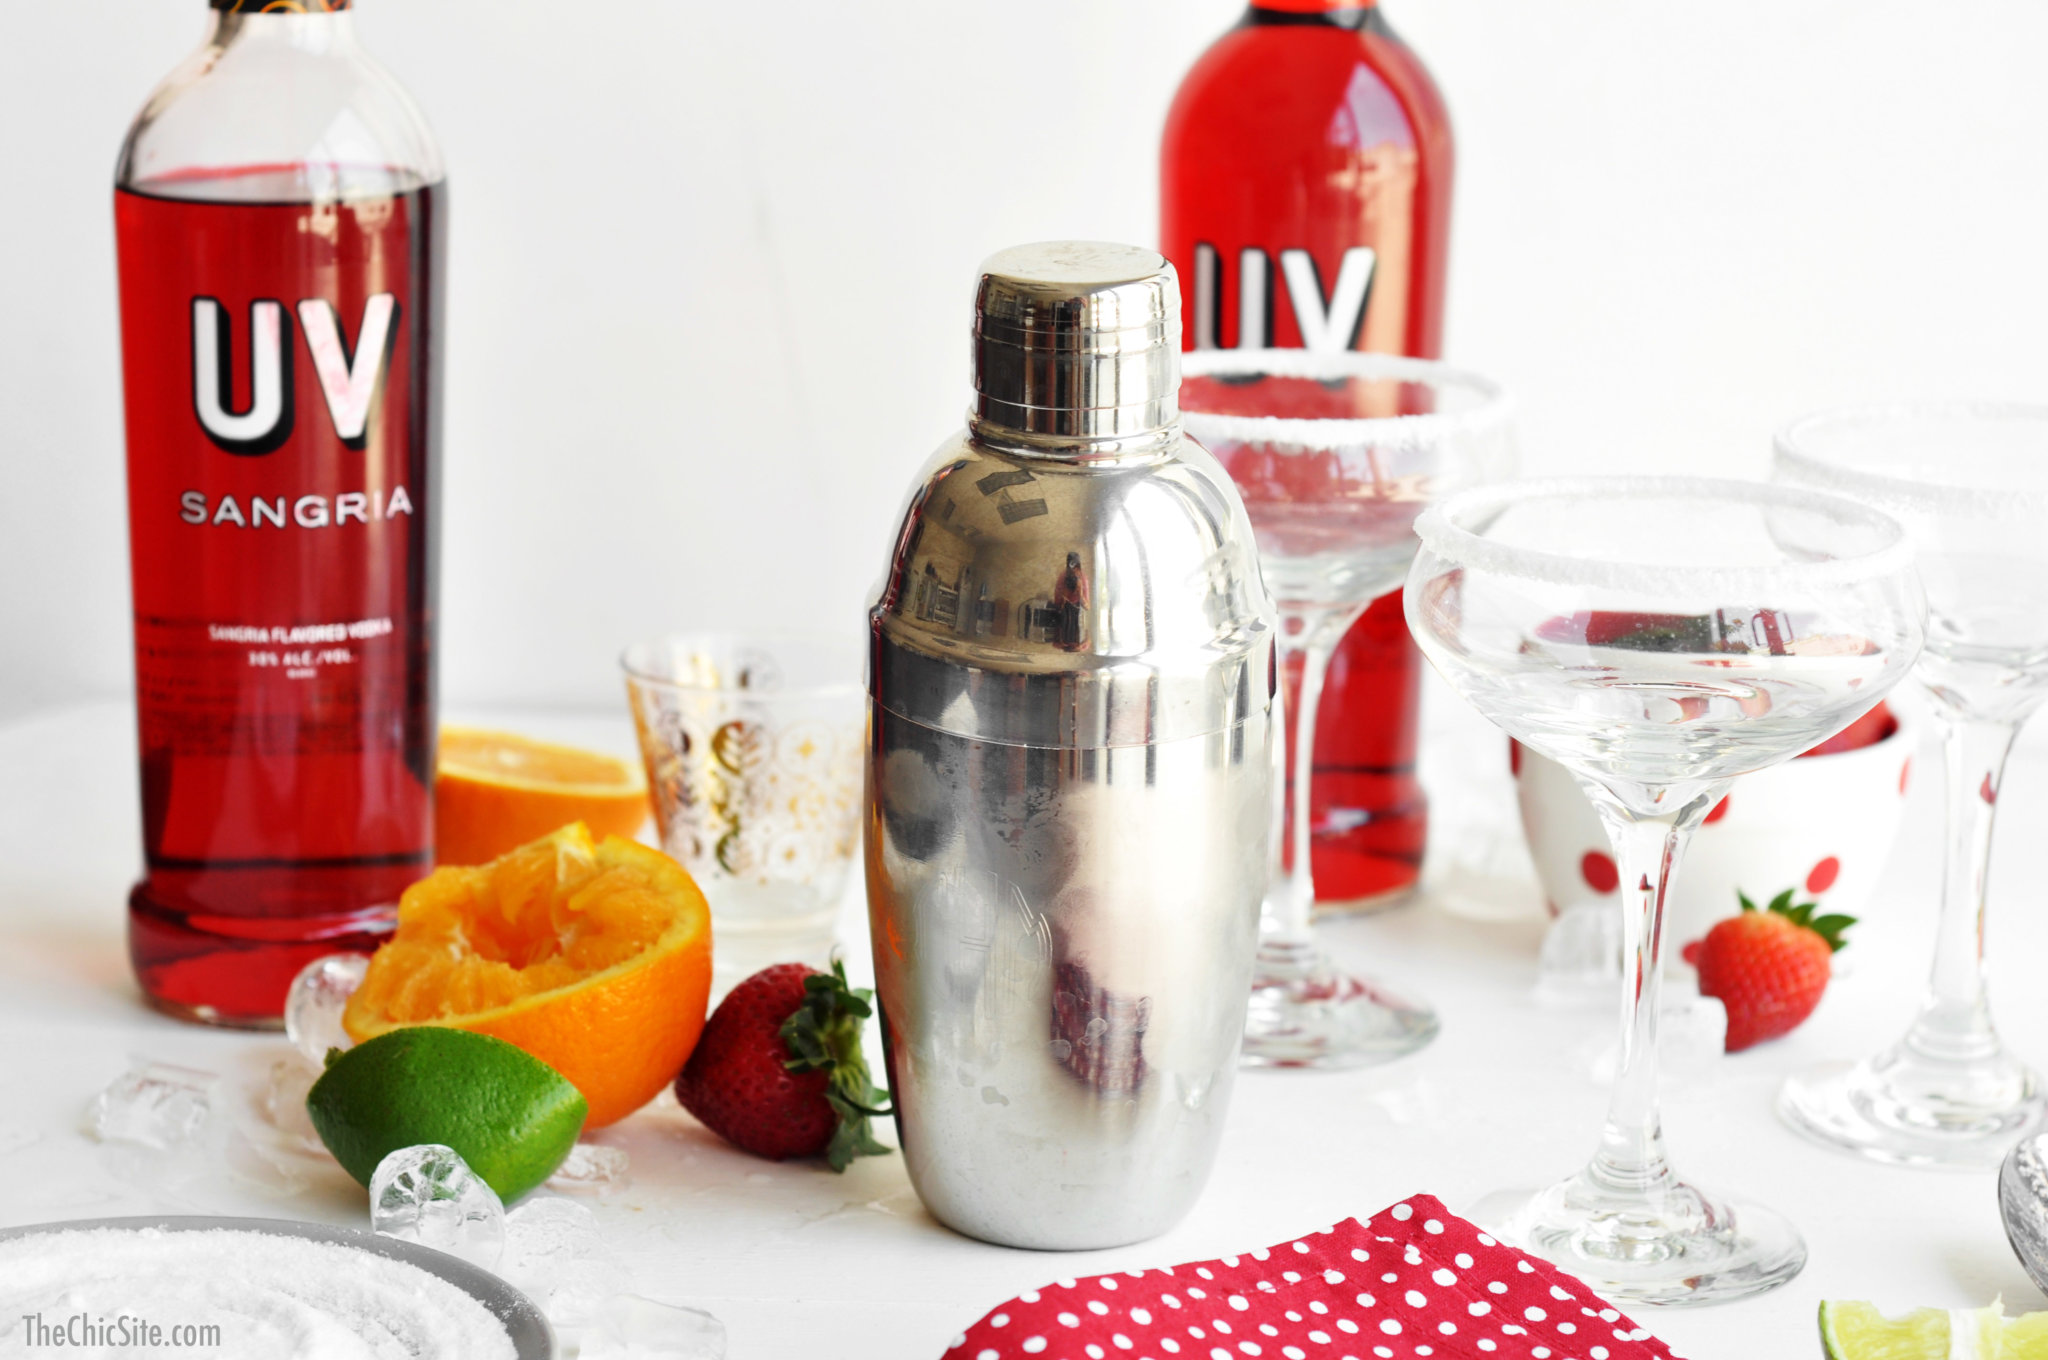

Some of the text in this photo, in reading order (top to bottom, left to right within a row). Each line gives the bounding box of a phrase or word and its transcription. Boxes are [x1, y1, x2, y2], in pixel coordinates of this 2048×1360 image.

[192, 293, 401, 455] UV
[1193, 241, 1376, 388] UV
[180, 485, 414, 529] SANGRIA
